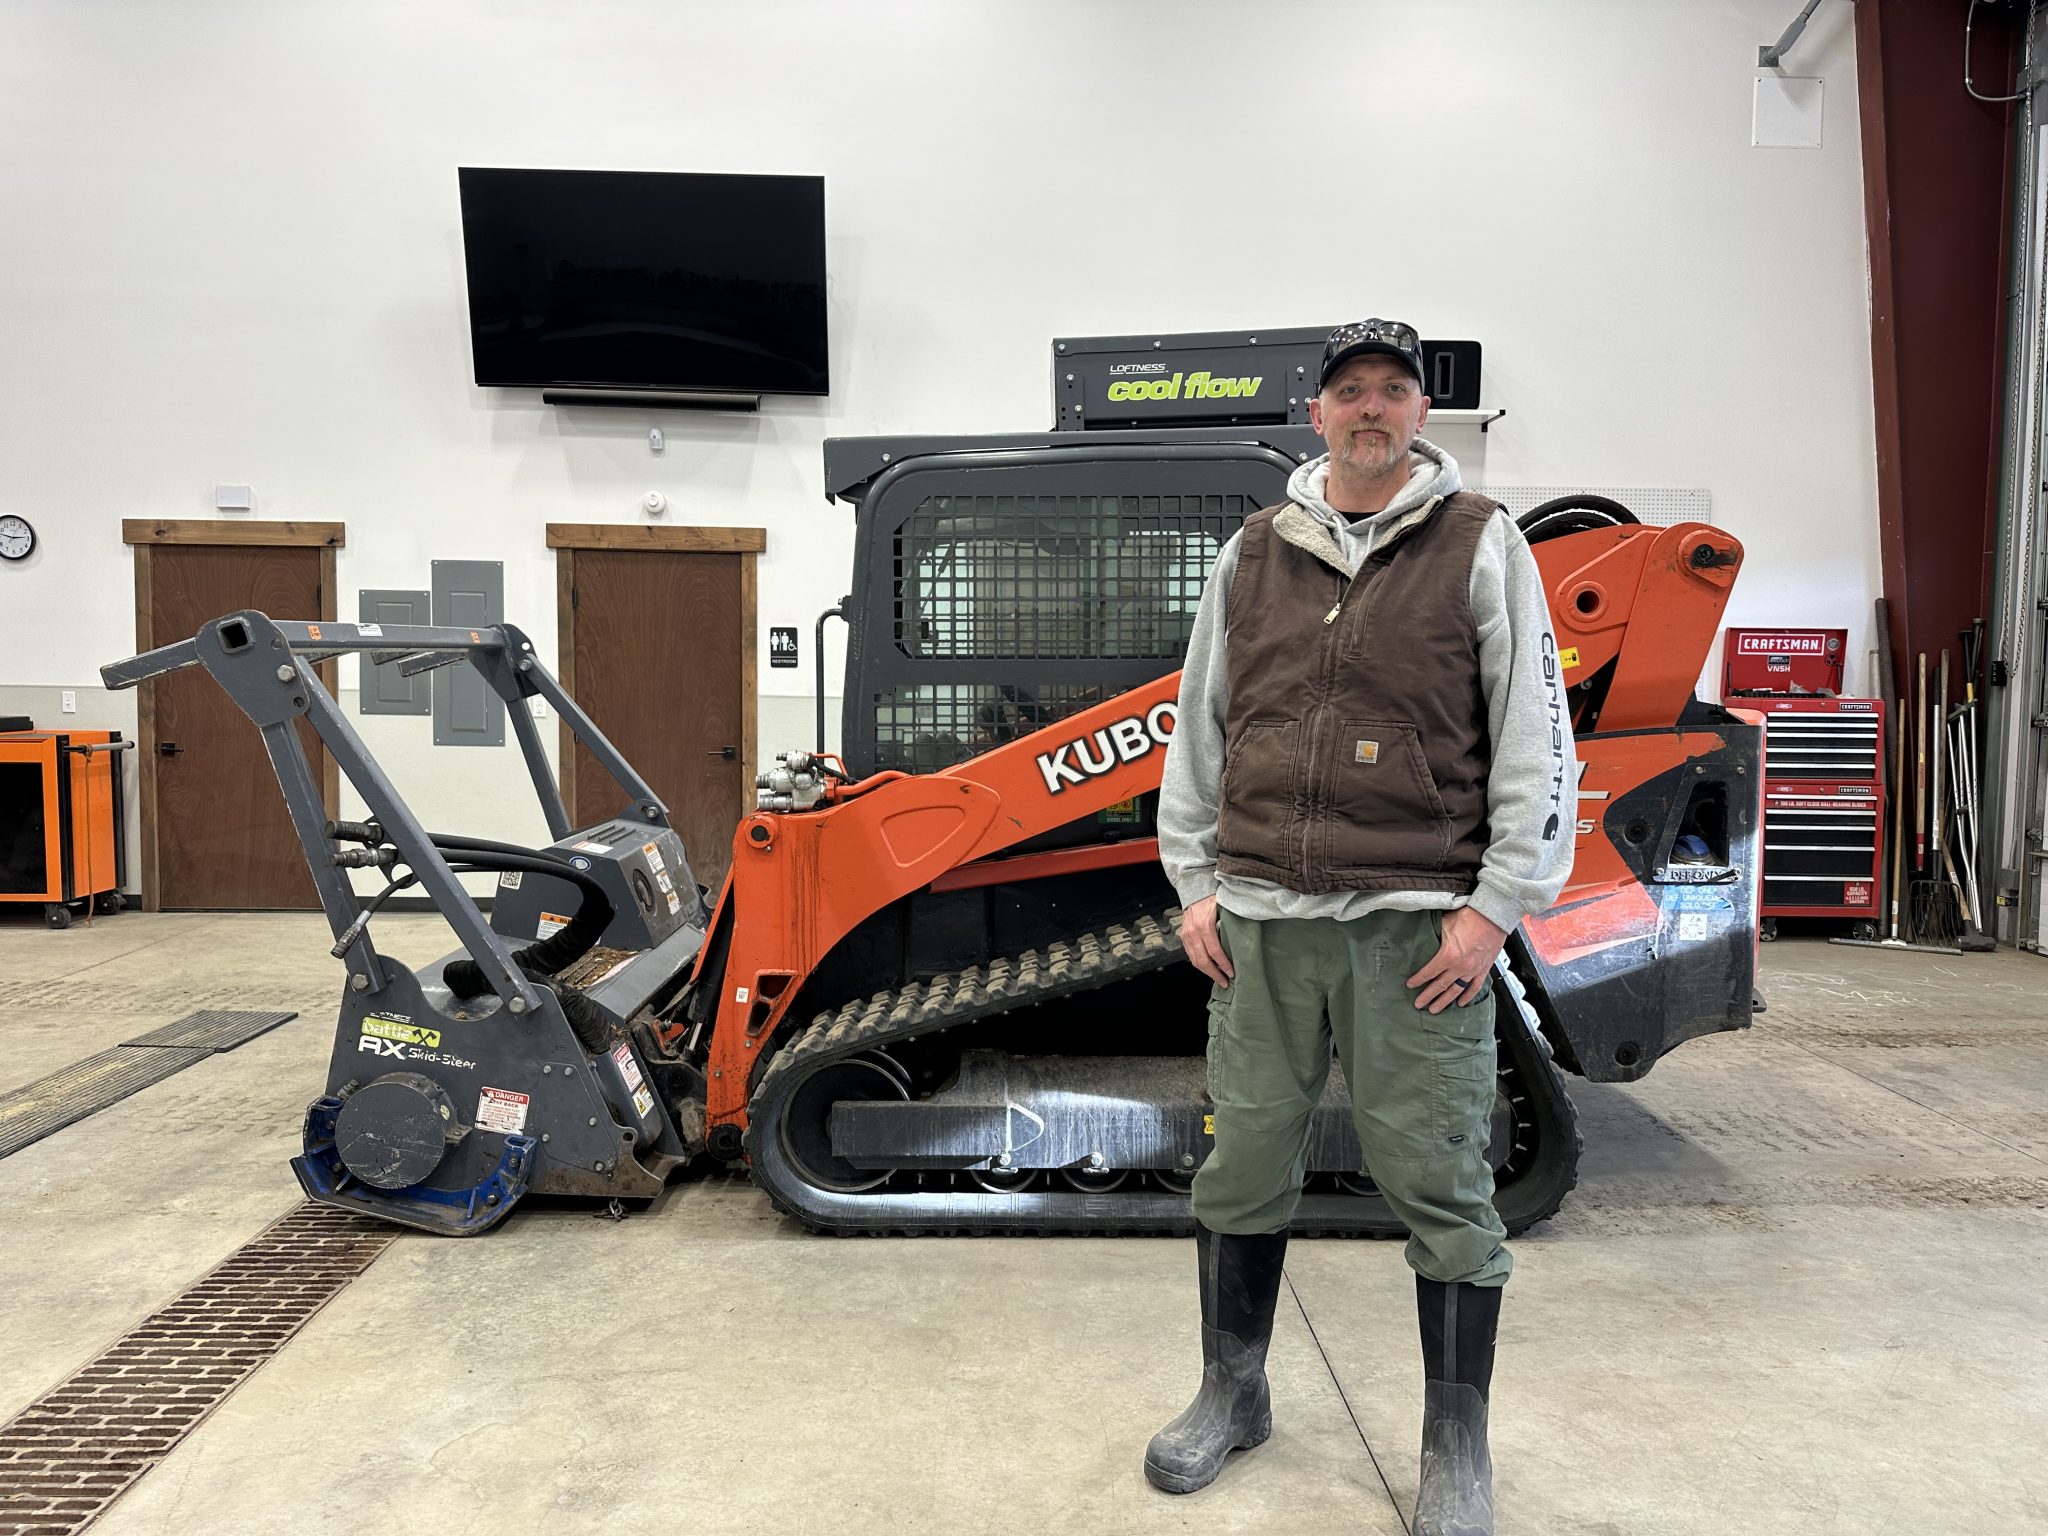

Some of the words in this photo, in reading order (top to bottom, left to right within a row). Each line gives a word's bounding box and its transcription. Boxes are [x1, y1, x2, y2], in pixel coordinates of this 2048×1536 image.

[1110, 363, 1166, 373] LOFTNESS
[1107, 372, 1183, 401] cool
[1184, 371, 1263, 399] flow
[1744, 638, 1819, 651] CRAFTSMAN
[358, 1035, 406, 1060] AX
[408, 1047, 477, 1070] Skid-Steer
[495, 1091, 524, 1103] DANGER
